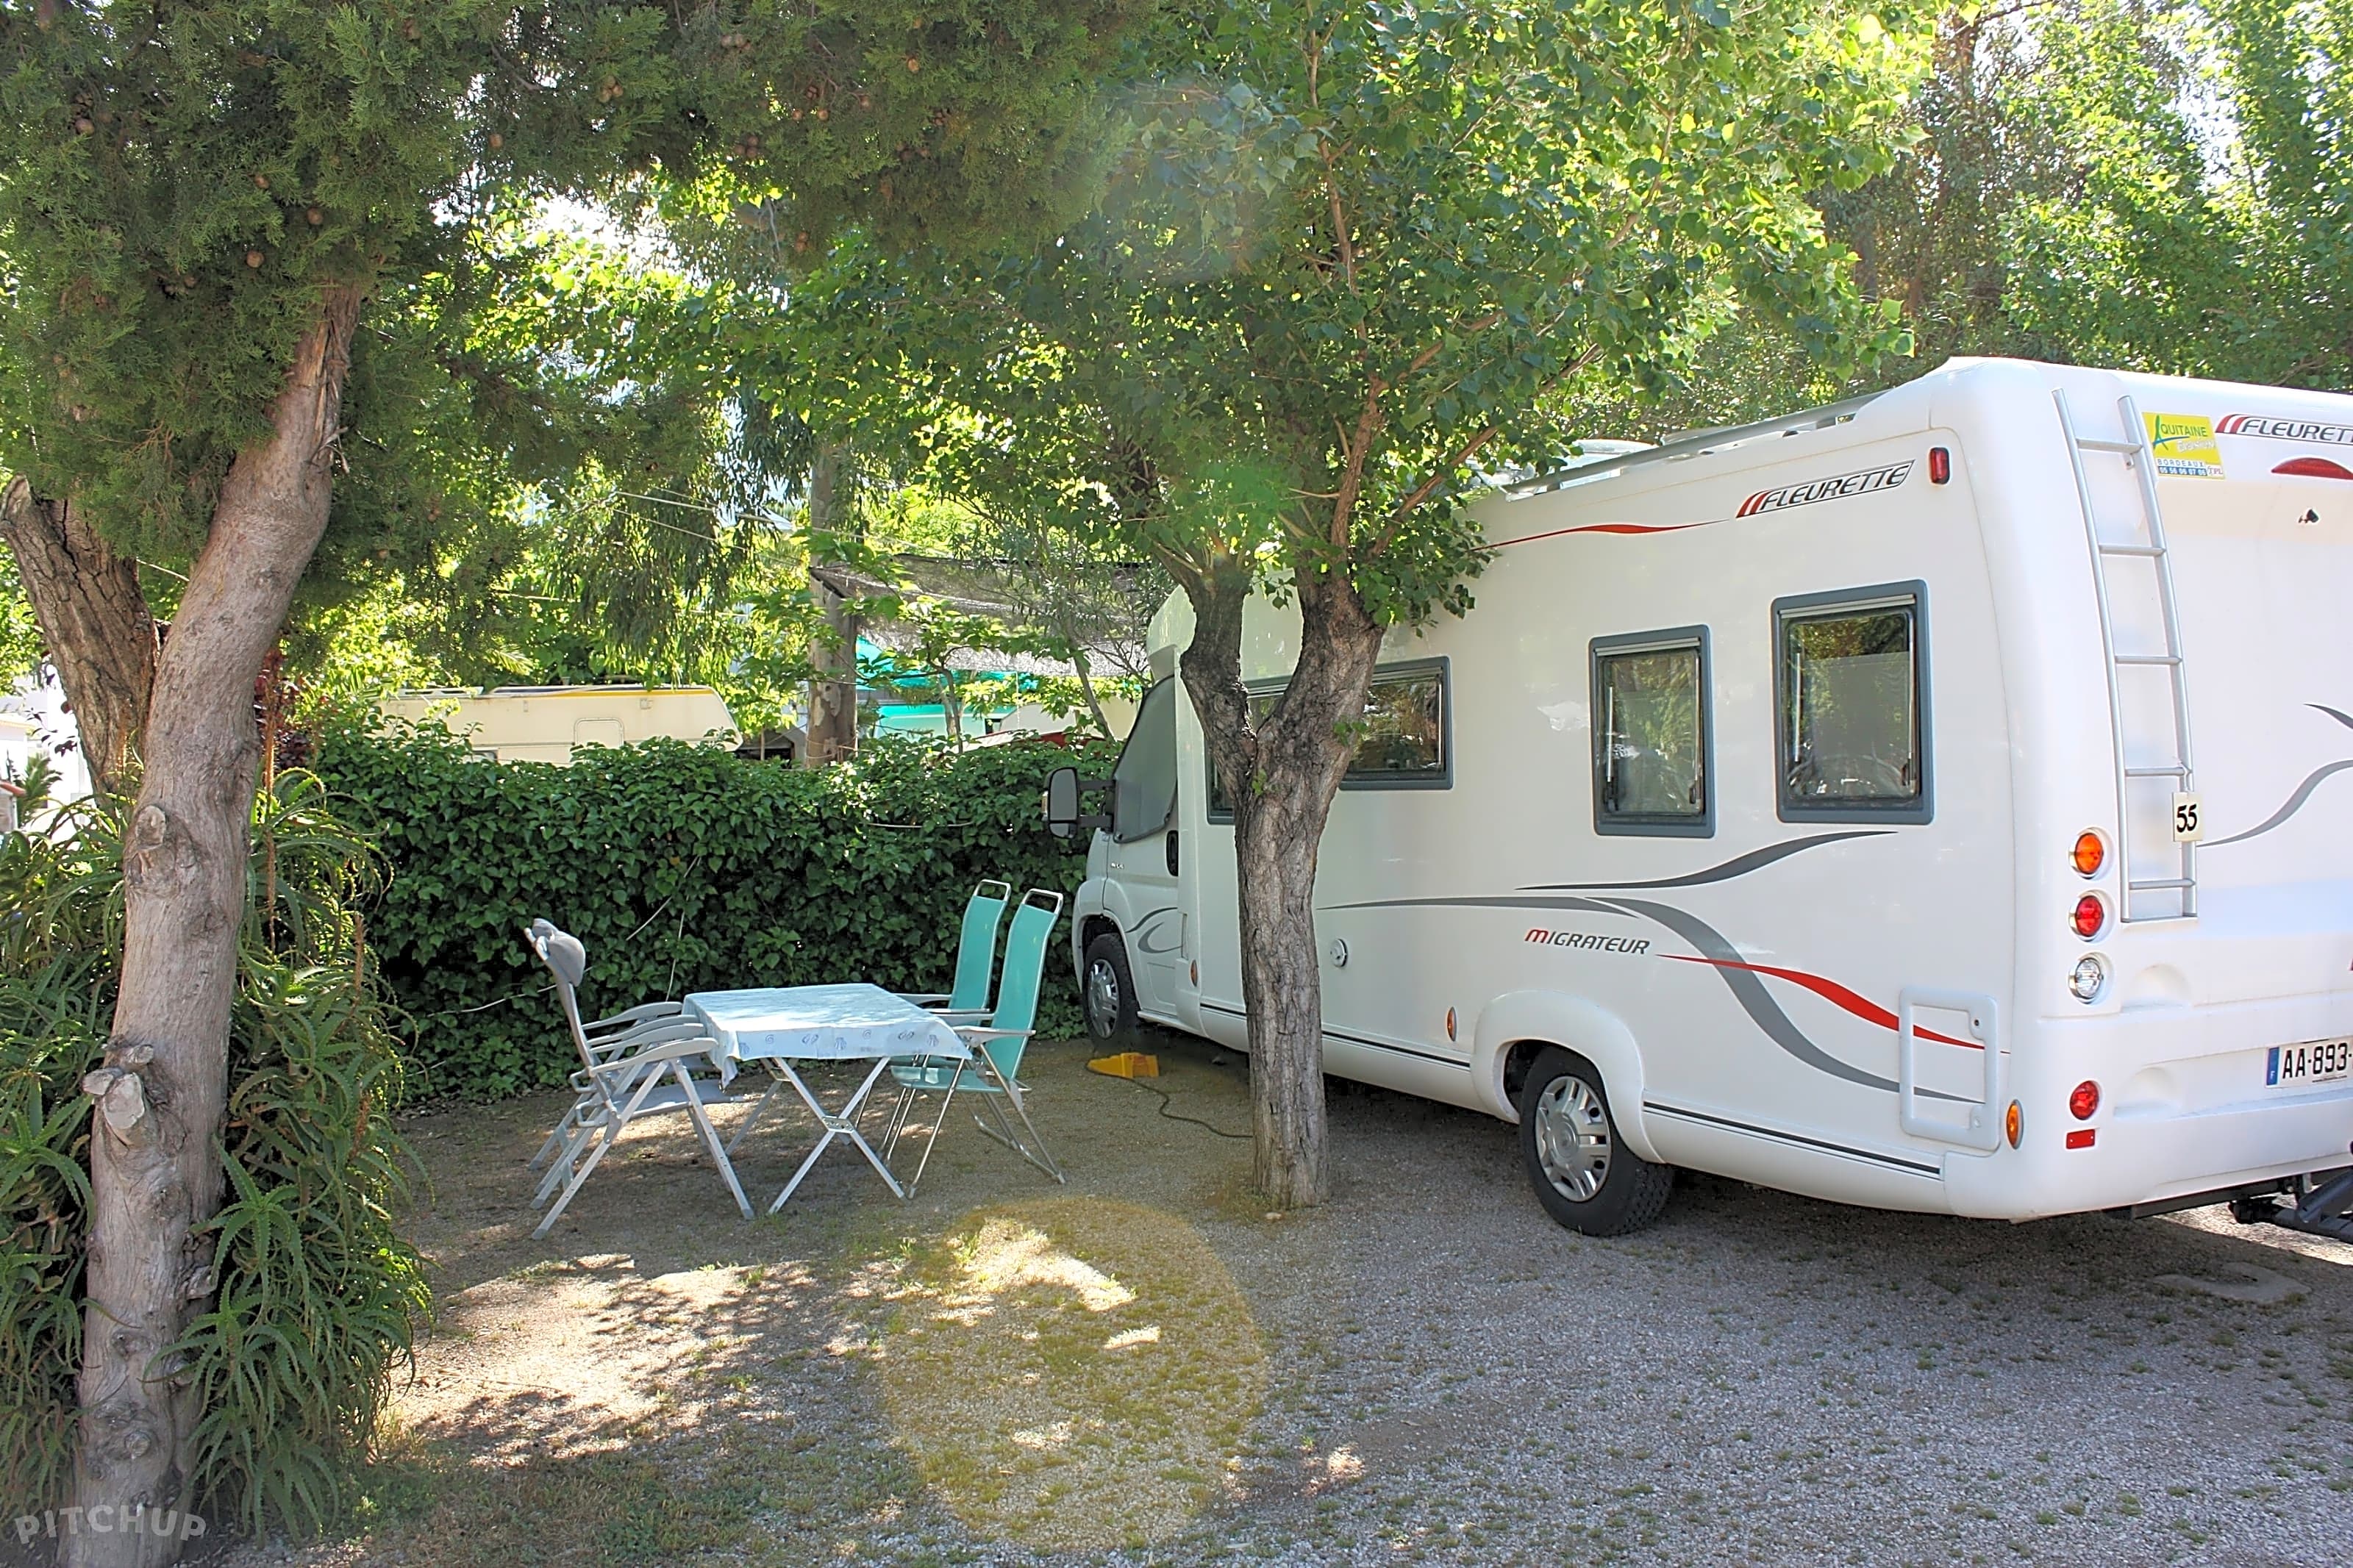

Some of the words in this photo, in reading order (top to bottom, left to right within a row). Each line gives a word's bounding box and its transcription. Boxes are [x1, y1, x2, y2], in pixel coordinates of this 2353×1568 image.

[2157, 458, 2204, 467] BORDEAUX
[1760, 465, 1910, 511] FLEURETTE
[2177, 803, 2198, 833] 55
[1524, 929, 1650, 954] MIGRATEUR
